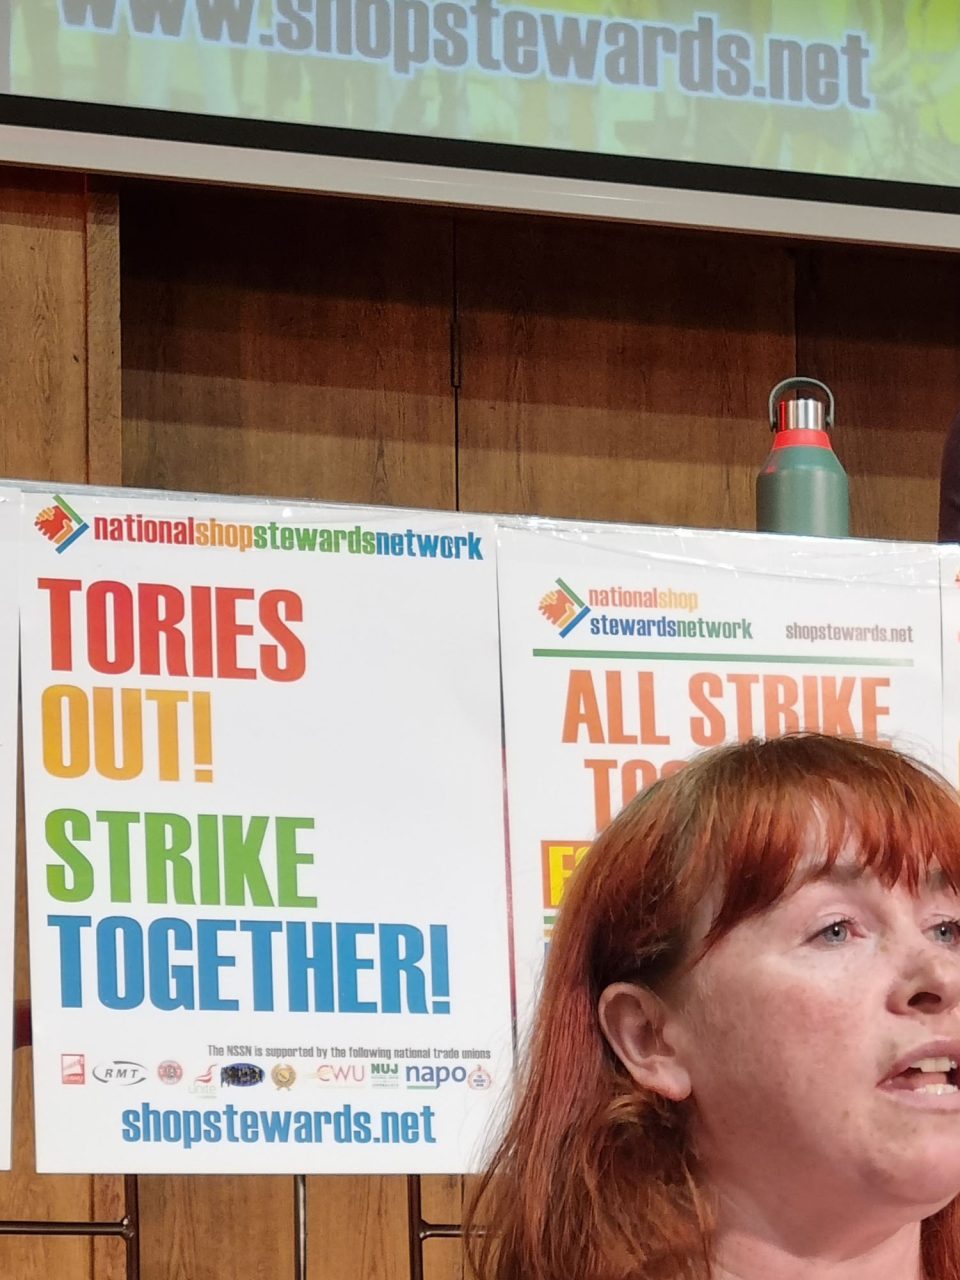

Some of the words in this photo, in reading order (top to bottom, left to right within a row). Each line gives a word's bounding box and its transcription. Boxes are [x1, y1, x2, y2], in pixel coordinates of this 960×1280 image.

[94, 514, 483, 560] nationalshopstewardsnetwork
[588, 586, 698, 612] nationalshop
[38, 578, 307, 682] TORIES
[590, 615, 753, 639] stewardsnetwork
[785, 621, 913, 643] shopstewards.net
[562, 670, 670, 745] ALL
[688, 671, 893, 747] STRIKE
[41, 685, 213, 783] OUT!
[45, 808, 318, 908] STRIKE
[47, 915, 451, 1014] TOGETHER!
[208, 1044, 224, 1056] The
[227, 1045, 251, 1057] NSSN
[254, 1045, 263, 1057] is
[265, 1046, 314, 1059] supported
[316, 1046, 327, 1059] by
[331, 1047, 346, 1058] the
[349, 1047, 391, 1060] following
[394, 1048, 431, 1059] national
[433, 1048, 458, 1060] trade
[461, 1048, 491, 1060] unions
[105, 1068, 139, 1078] RMT
[316, 1064, 365, 1082] CWU
[371, 1063, 398, 1074] NUJ
[406, 1065, 467, 1089] napo
[122, 1102, 436, 1149] shopstewards.net
